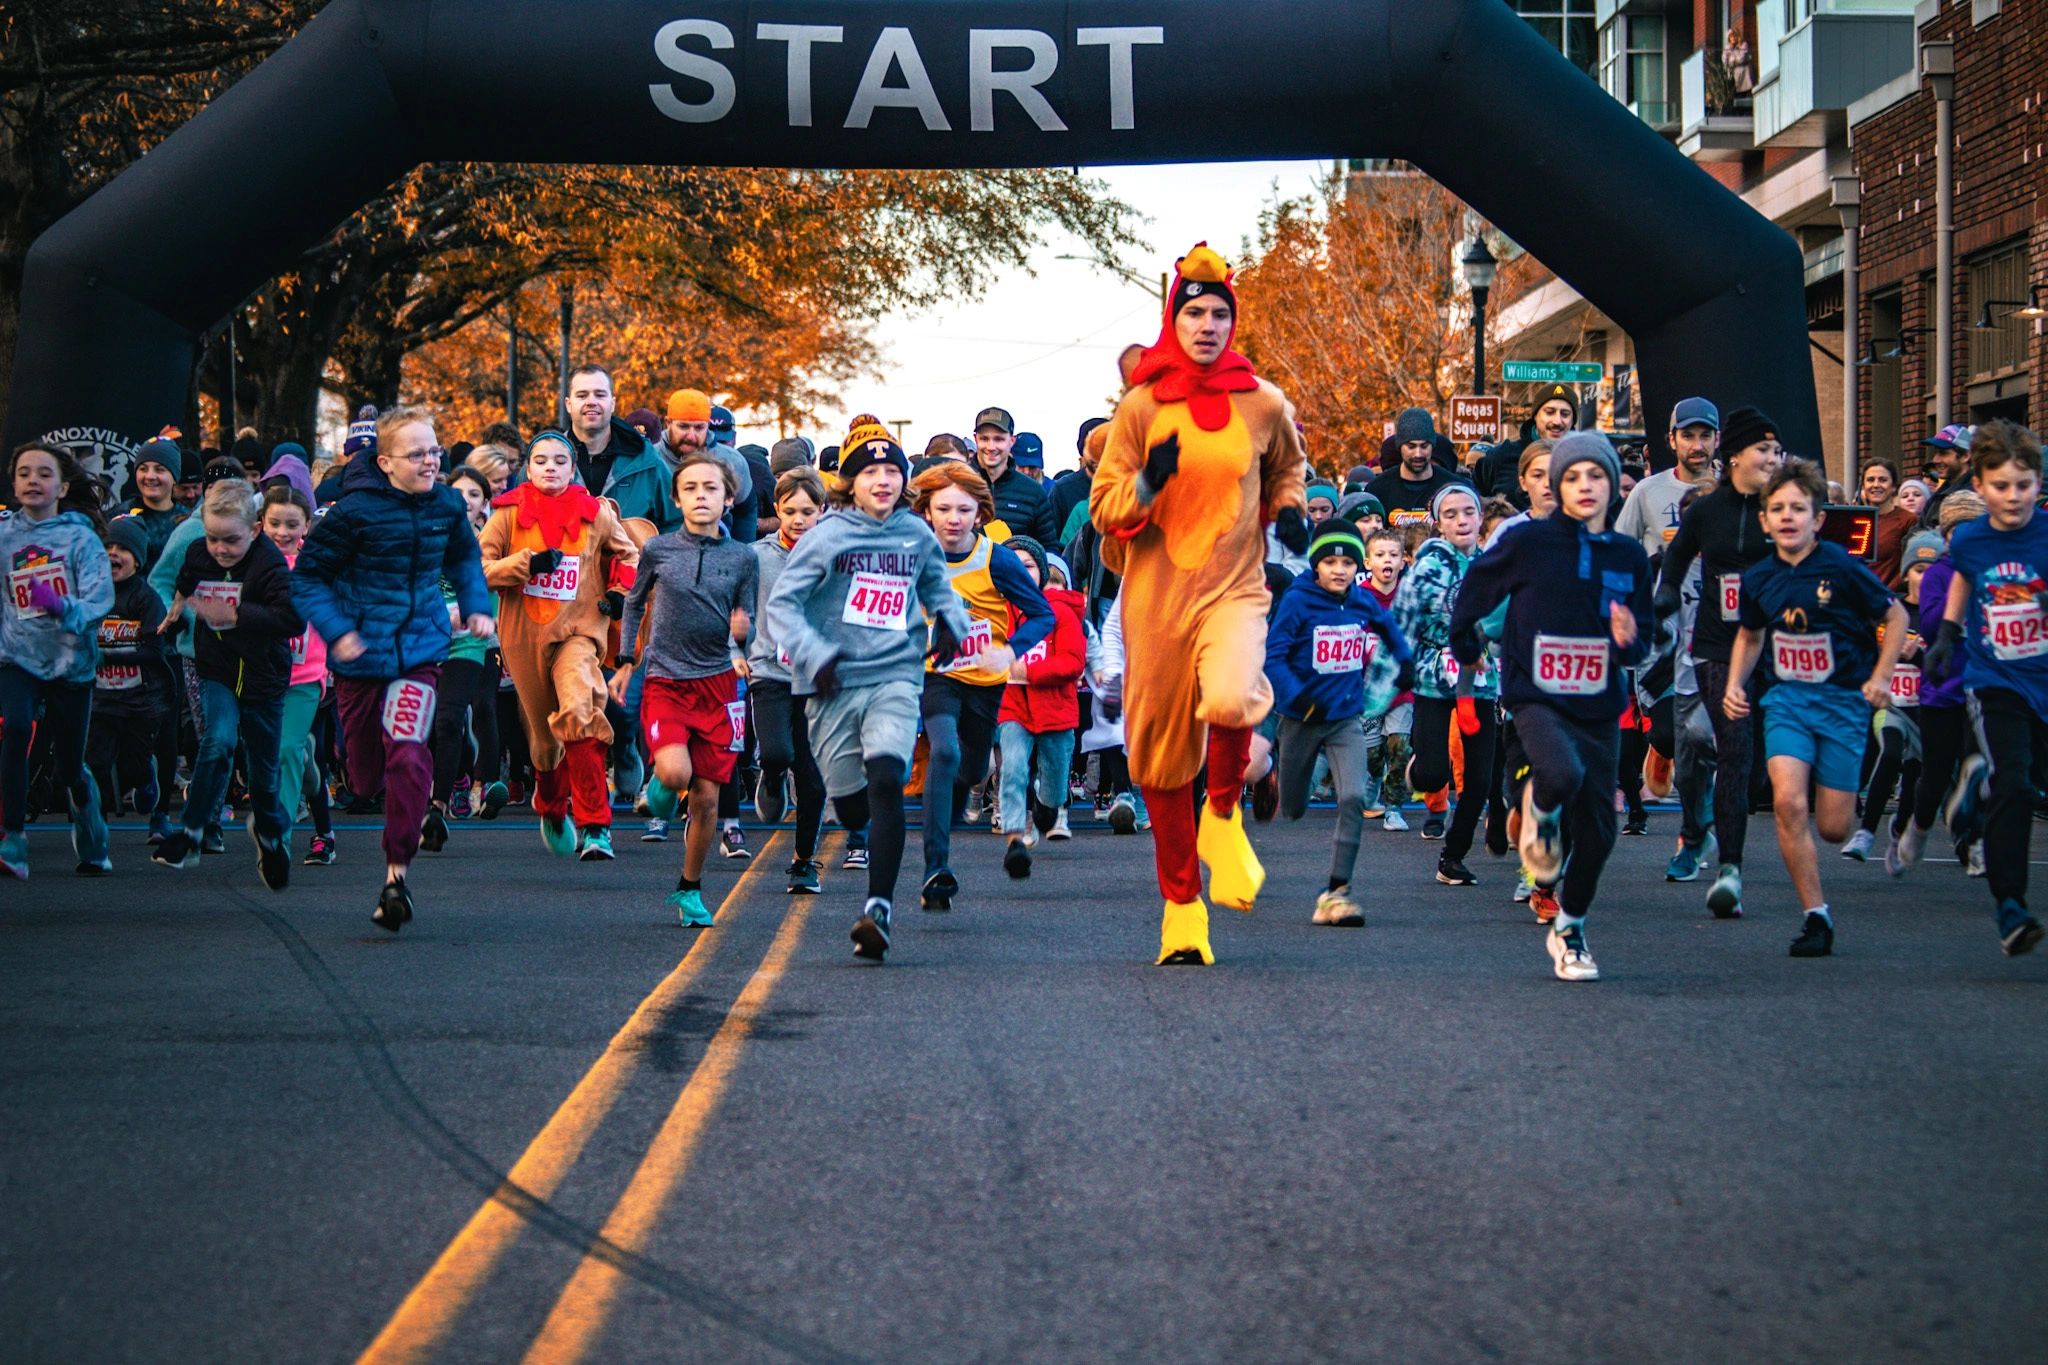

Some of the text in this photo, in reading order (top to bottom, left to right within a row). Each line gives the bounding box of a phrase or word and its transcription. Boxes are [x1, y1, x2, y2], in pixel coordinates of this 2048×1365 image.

[648, 19, 1164, 132] START
[1506, 365, 1557, 379] Williams
[1457, 401, 1493, 420] Regas
[352, 424, 376, 434] VIKIN
[1454, 421, 1497, 438] Square
[41, 427, 141, 457] KNOXVILLE
[867, 441, 889, 459] T
[1848, 520, 1871, 554] 3
[835, 552, 873, 575] WEST
[851, 587, 904, 616] 4769
[1782, 607, 1808, 632] 10
[1316, 637, 1363, 663] 8426
[1778, 647, 1829, 672] 4798
[1540, 652, 1603, 681] 8375
[392, 683, 423, 736] 4882
